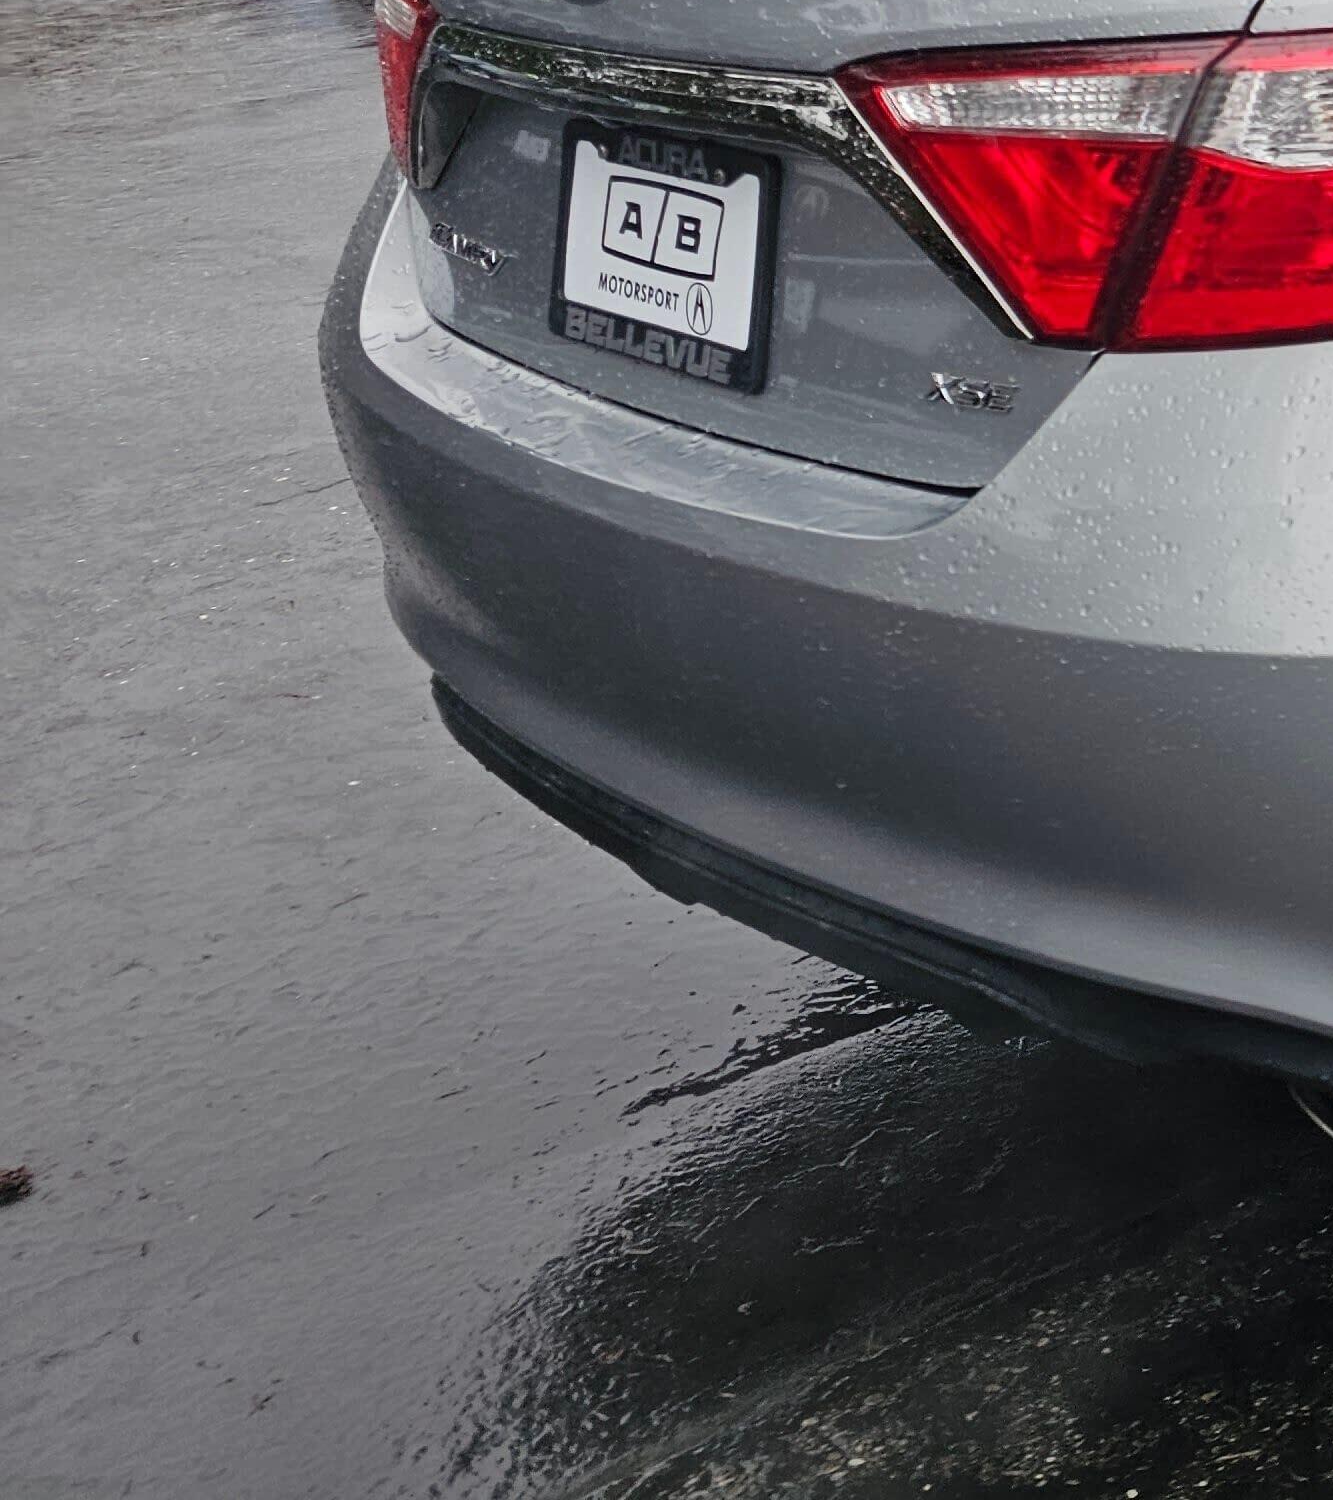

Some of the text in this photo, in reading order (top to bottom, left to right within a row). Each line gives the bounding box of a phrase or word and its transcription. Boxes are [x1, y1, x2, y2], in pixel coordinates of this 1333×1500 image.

[617, 132, 710, 182] ACURA
[598, 272, 679, 312] MOTORSPORT
[564, 306, 732, 385] BELLEVUE
